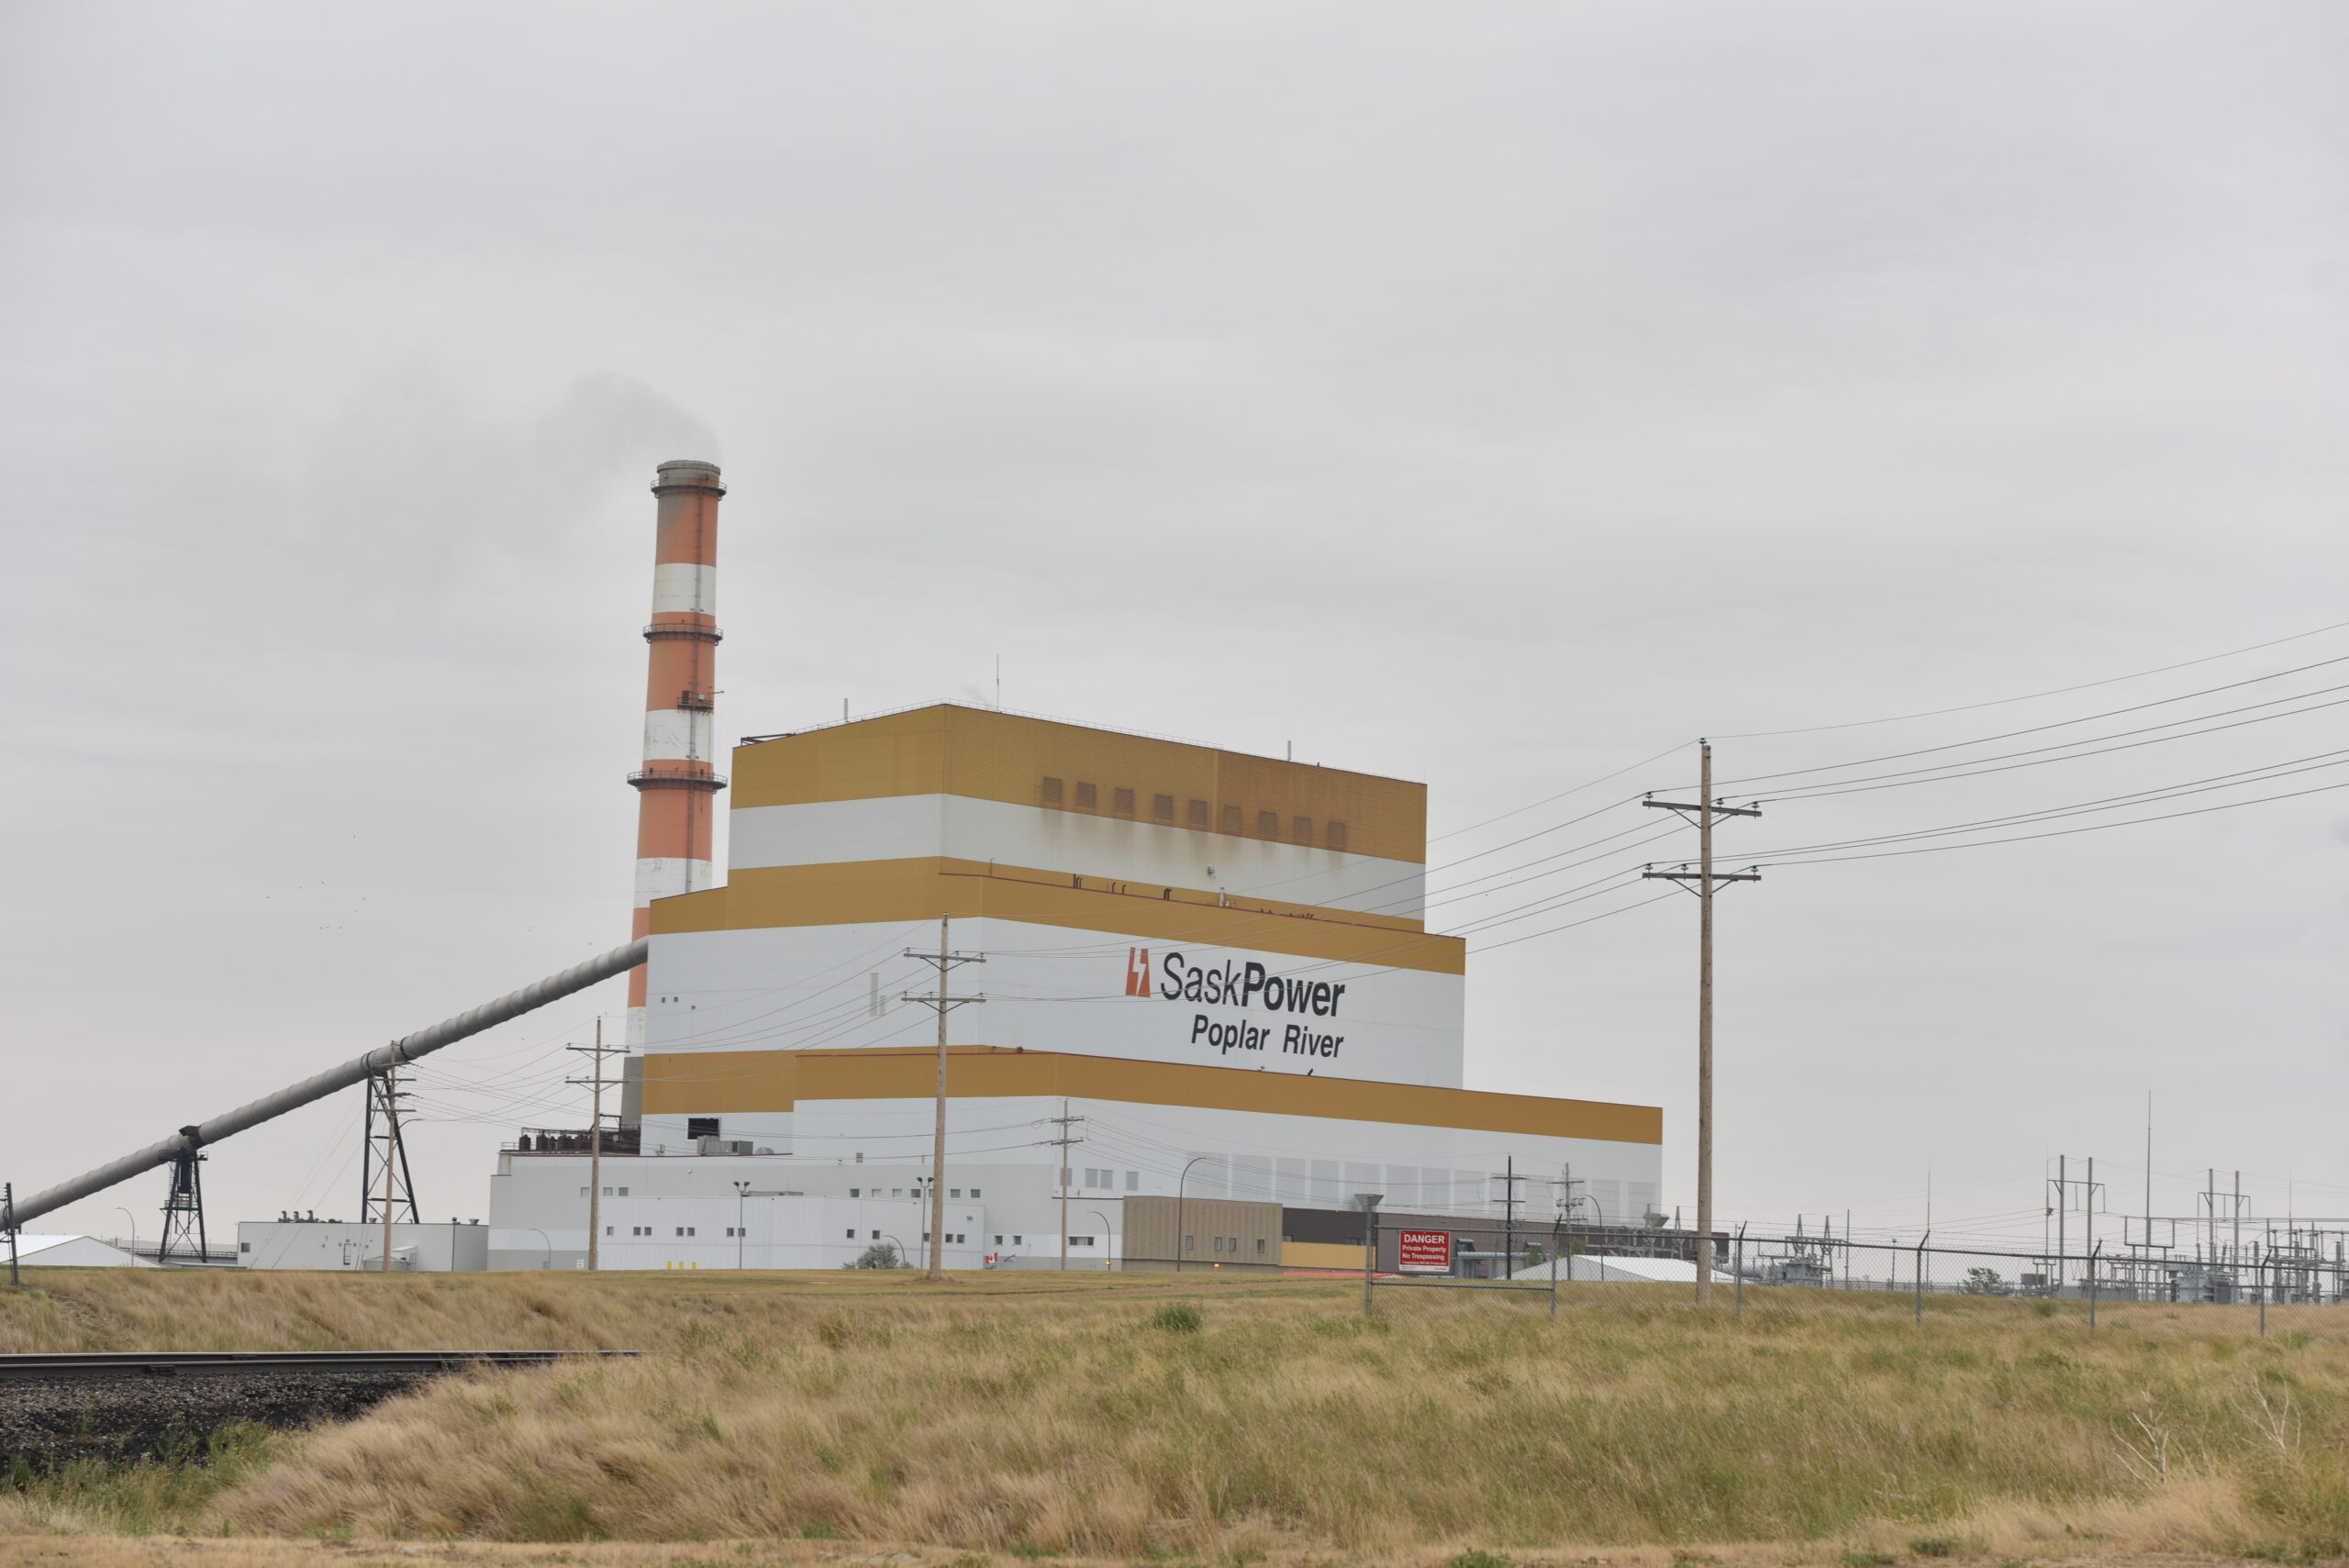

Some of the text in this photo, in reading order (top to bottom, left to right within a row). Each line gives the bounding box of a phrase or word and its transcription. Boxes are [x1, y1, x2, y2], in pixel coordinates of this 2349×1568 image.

[1161, 952, 1345, 1017] SaskPower
[1191, 1014, 1344, 1057] Poplar River
[1404, 1234, 1445, 1244] DANGER
